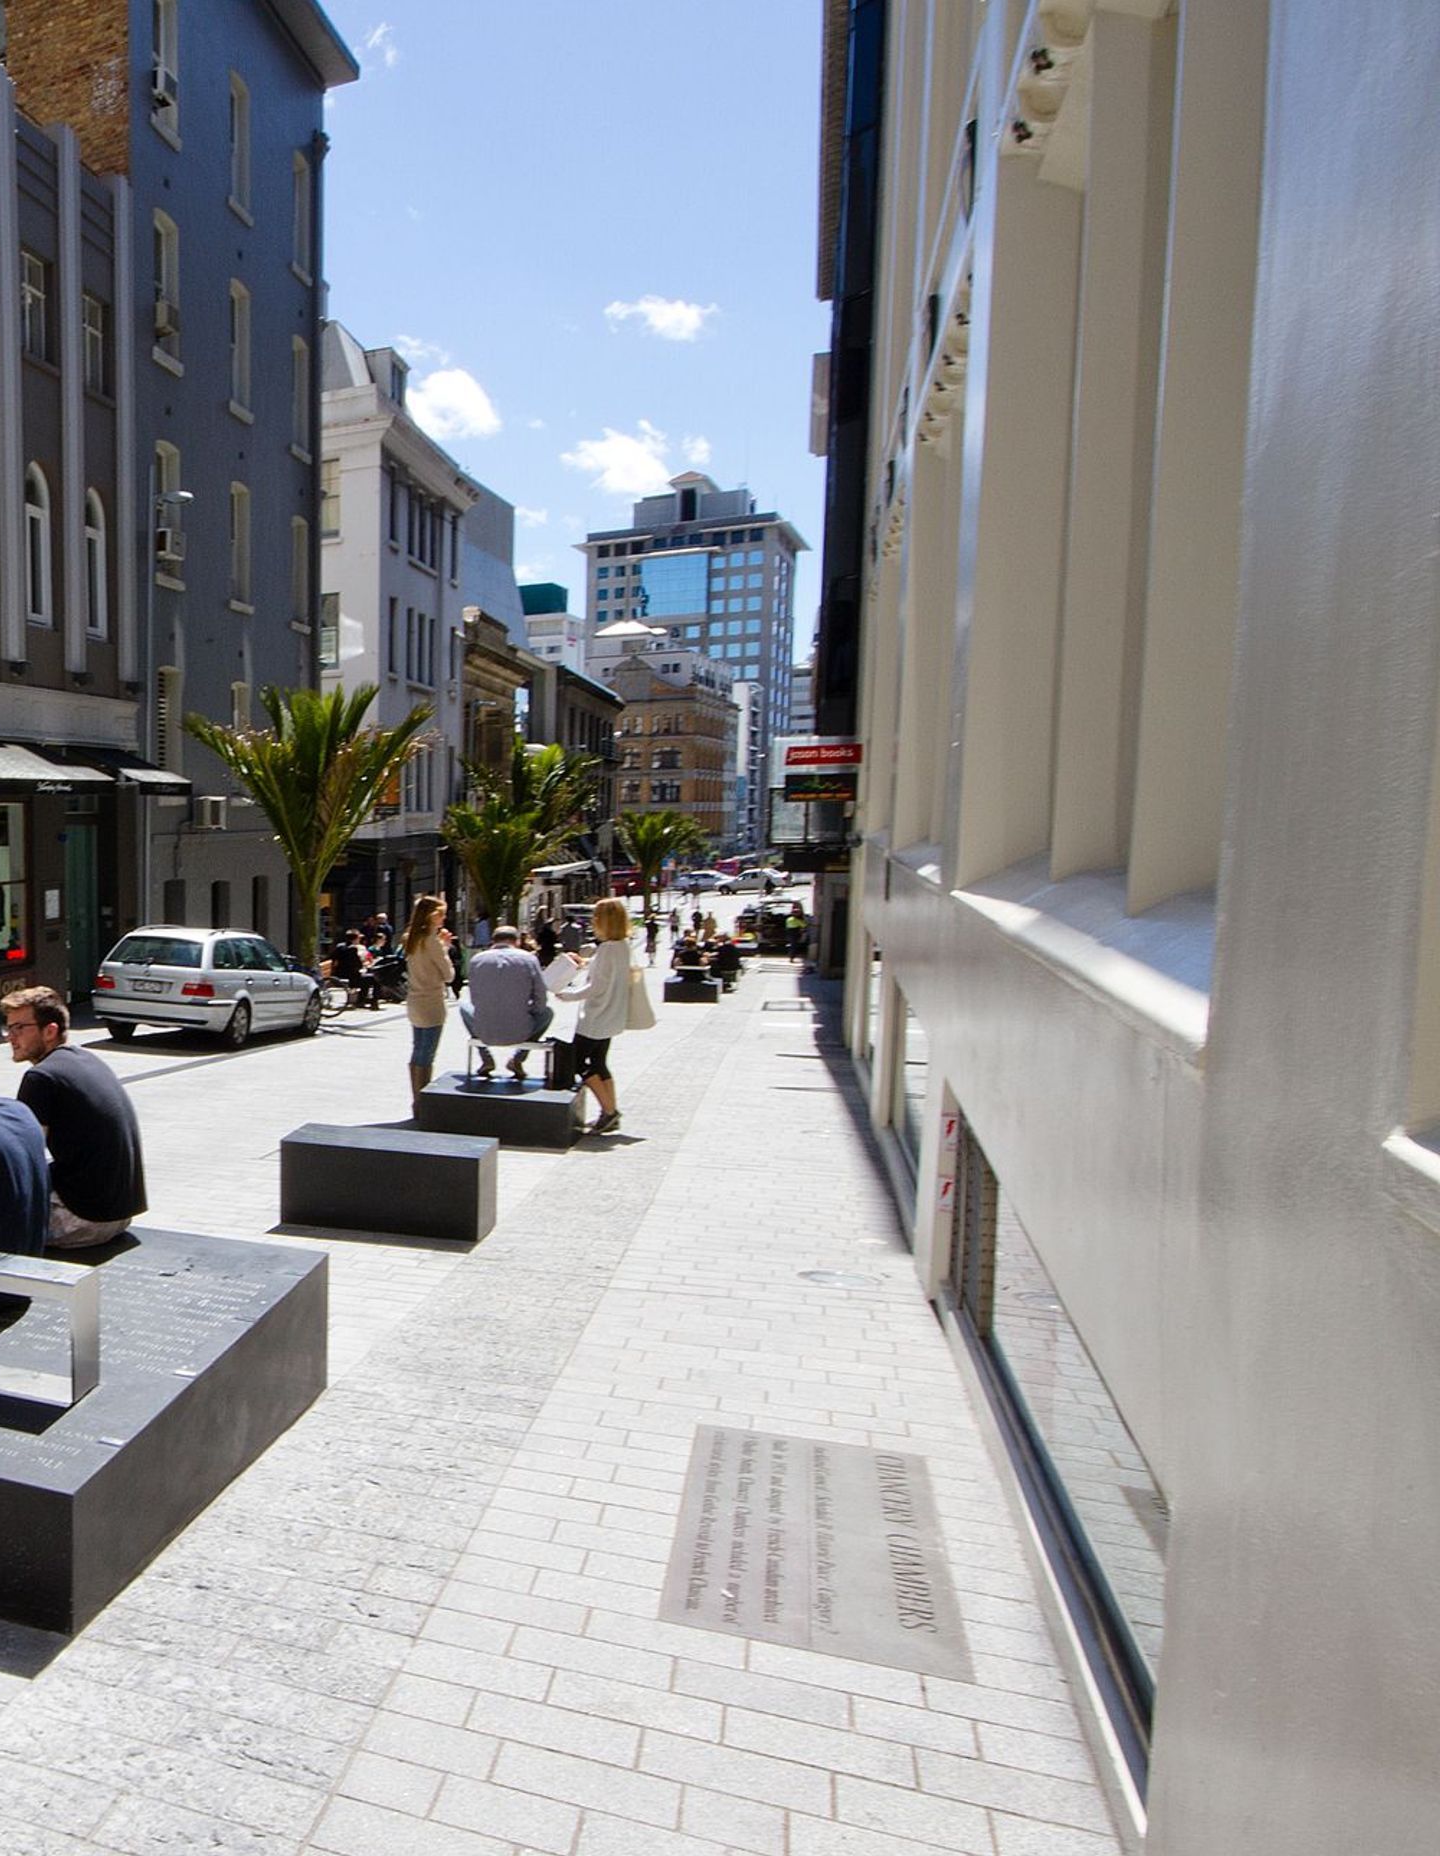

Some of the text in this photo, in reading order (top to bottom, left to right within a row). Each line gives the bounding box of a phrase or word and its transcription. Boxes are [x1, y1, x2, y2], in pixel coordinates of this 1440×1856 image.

[820, 747, 855, 759] books
[875, 1453, 938, 1637] CHANCERY CHAMBERS
[811, 1584, 838, 1626] Category
